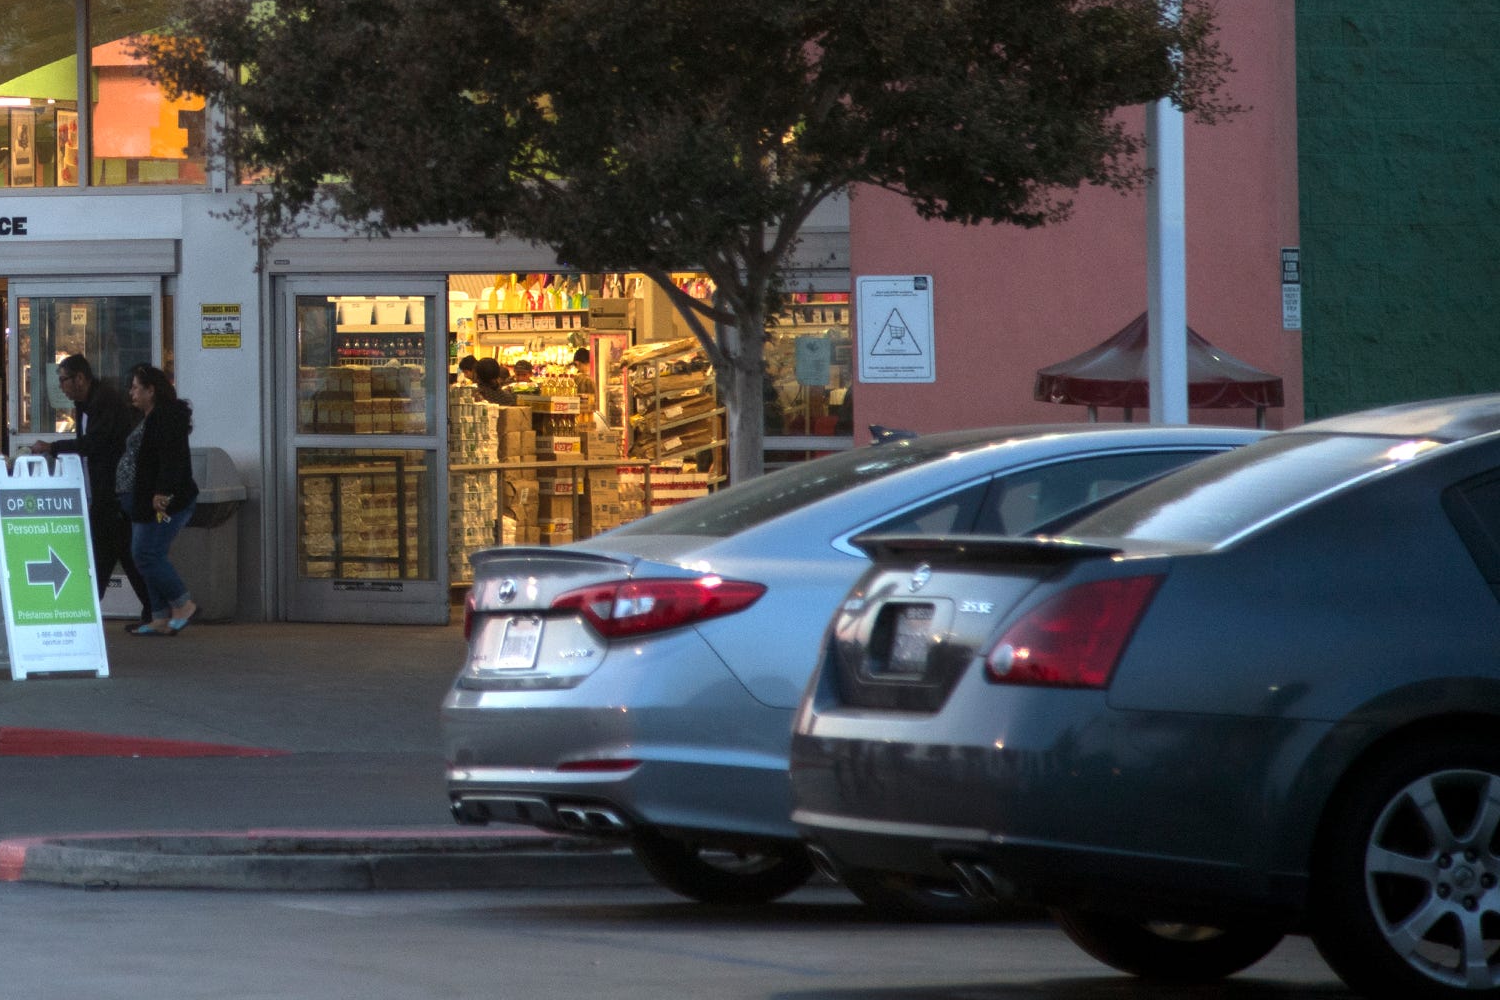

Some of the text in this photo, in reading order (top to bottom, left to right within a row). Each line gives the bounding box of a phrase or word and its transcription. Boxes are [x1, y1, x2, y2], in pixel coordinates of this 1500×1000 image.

[7, 495, 73, 511] OPORTUN
[7, 521, 80, 535] Personal Loans
